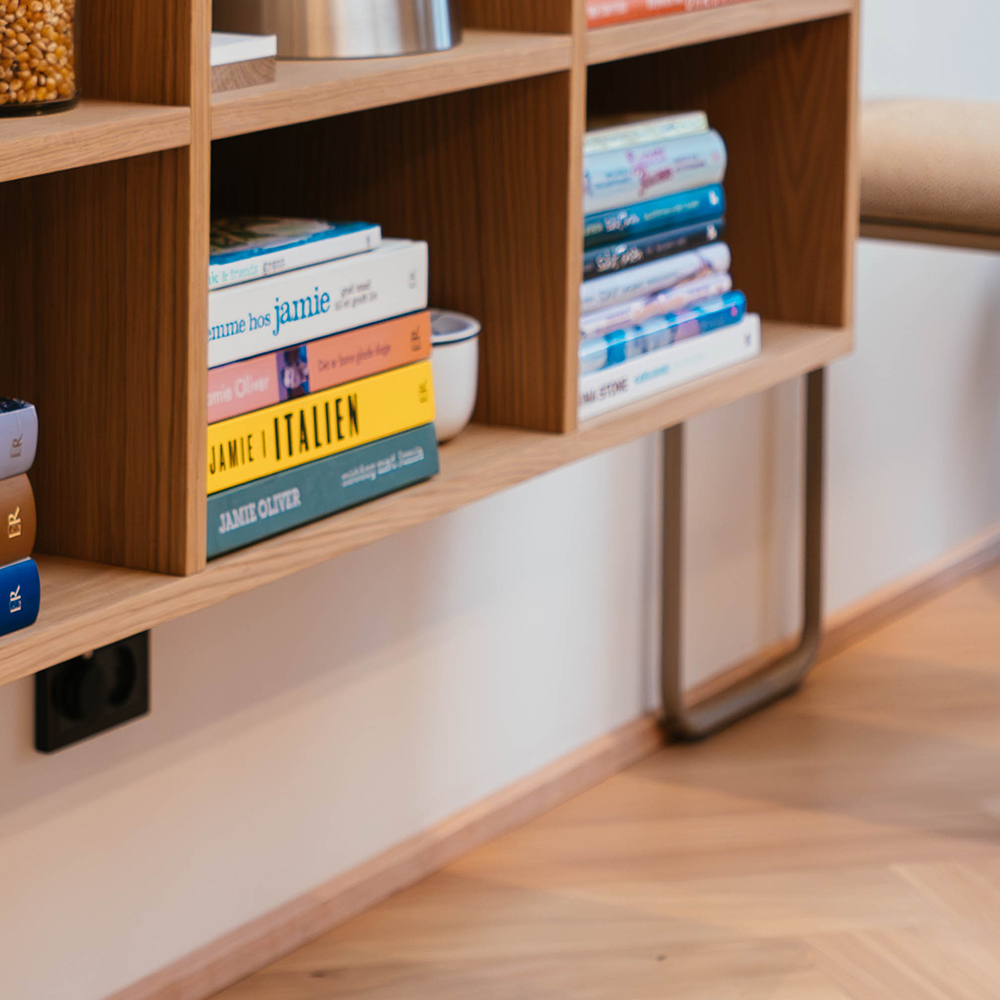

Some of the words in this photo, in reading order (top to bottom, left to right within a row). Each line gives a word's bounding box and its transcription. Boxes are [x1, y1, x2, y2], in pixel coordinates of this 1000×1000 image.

[248, 313, 271, 331] hos
[272, 286, 331, 336] jamie
[234, 374, 269, 399] Oliver
[209, 434, 255, 475] JAMIE
[274, 393, 359, 461] ITALIEN
[218, 503, 257, 534] JAMIE
[257, 487, 302, 519] OLIVER
